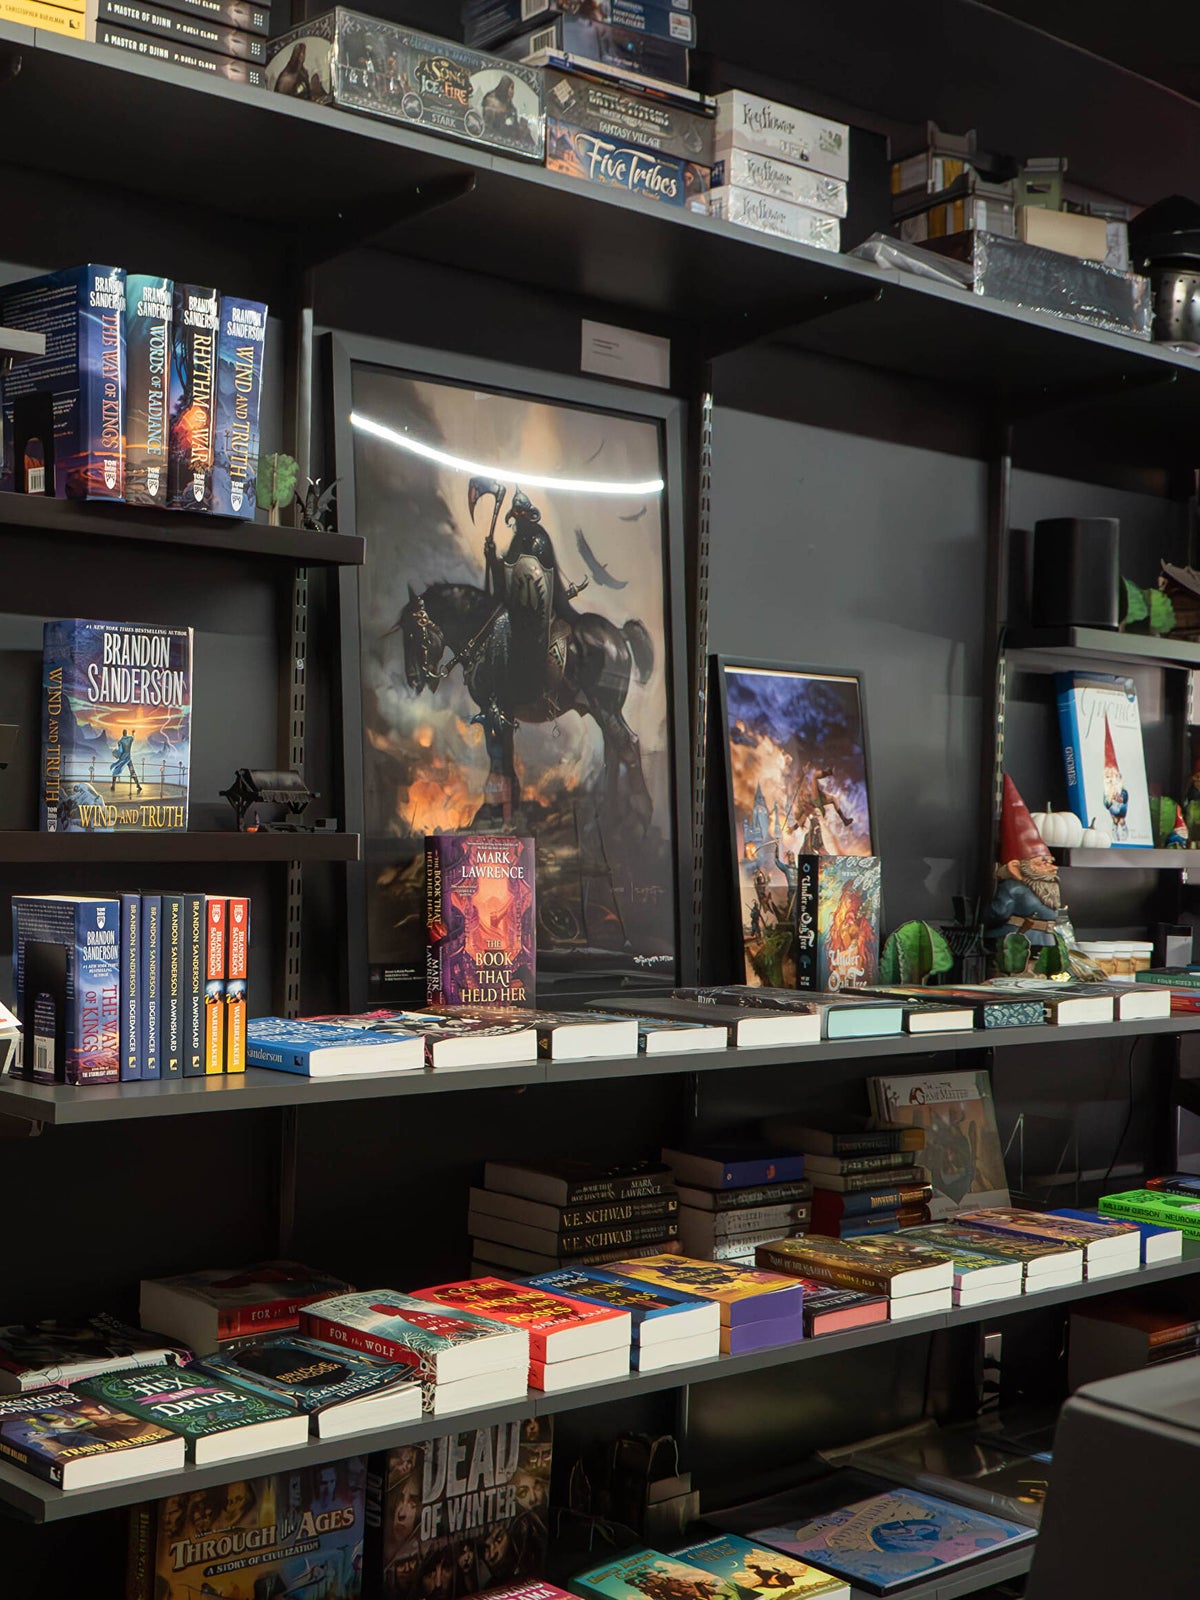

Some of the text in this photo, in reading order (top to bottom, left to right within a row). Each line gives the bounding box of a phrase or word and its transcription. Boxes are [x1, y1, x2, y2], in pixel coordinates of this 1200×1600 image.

[104, 33, 169, 58] A MASTER OF DJINN
[445, 82, 467, 105] FIRE
[432, 114, 456, 128] STARK
[742, 103, 794, 134] Keyflower
[600, 121, 660, 148] FANTASY VILLAGE
[575, 133, 677, 197] Five Tribes
[95, 277, 124, 295] BRANDON
[90, 292, 126, 311] SANDERSON
[148, 326, 165, 455] WORDS OF RADIANCE
[191, 334, 211, 463] RHYTHM OF WAR
[104, 633, 170, 668] BRANDON
[88, 663, 184, 707] SANDERSON
[1064, 747, 1076, 786] GNOMES
[78, 804, 184, 828] WIND AND TRUTH
[477, 852, 511, 864] MARK
[462, 867, 524, 879] LAWRENCE
[86, 931, 115, 945] BRANDON
[486, 940, 501, 948] THE
[83, 946, 118, 960] SANDERSON
[475, 952, 513, 966] BOOK
[828, 944, 860, 967] Under
[477, 970, 512, 986] THAT
[847, 967, 867, 988] Tree
[462, 988, 526, 1002] HELD HER
[585, 1205, 632, 1223] SCHWAB
[1103, 1202, 1159, 1218] WILLIAM GIBSON
[449, 1282, 505, 1297] COURT
[467, 1292, 547, 1312] THORNS
[505, 1304, 573, 1324] ROSES
[329, 1328, 395, 1358] FOR WOLF
[128, 1377, 196, 1398] HEX
[150, 1391, 248, 1417] DRIVE
[422, 1420, 520, 1504] DEAD
[420, 1484, 517, 1542] OF WINTER
[170, 1507, 355, 1572] THROUGH AGES
